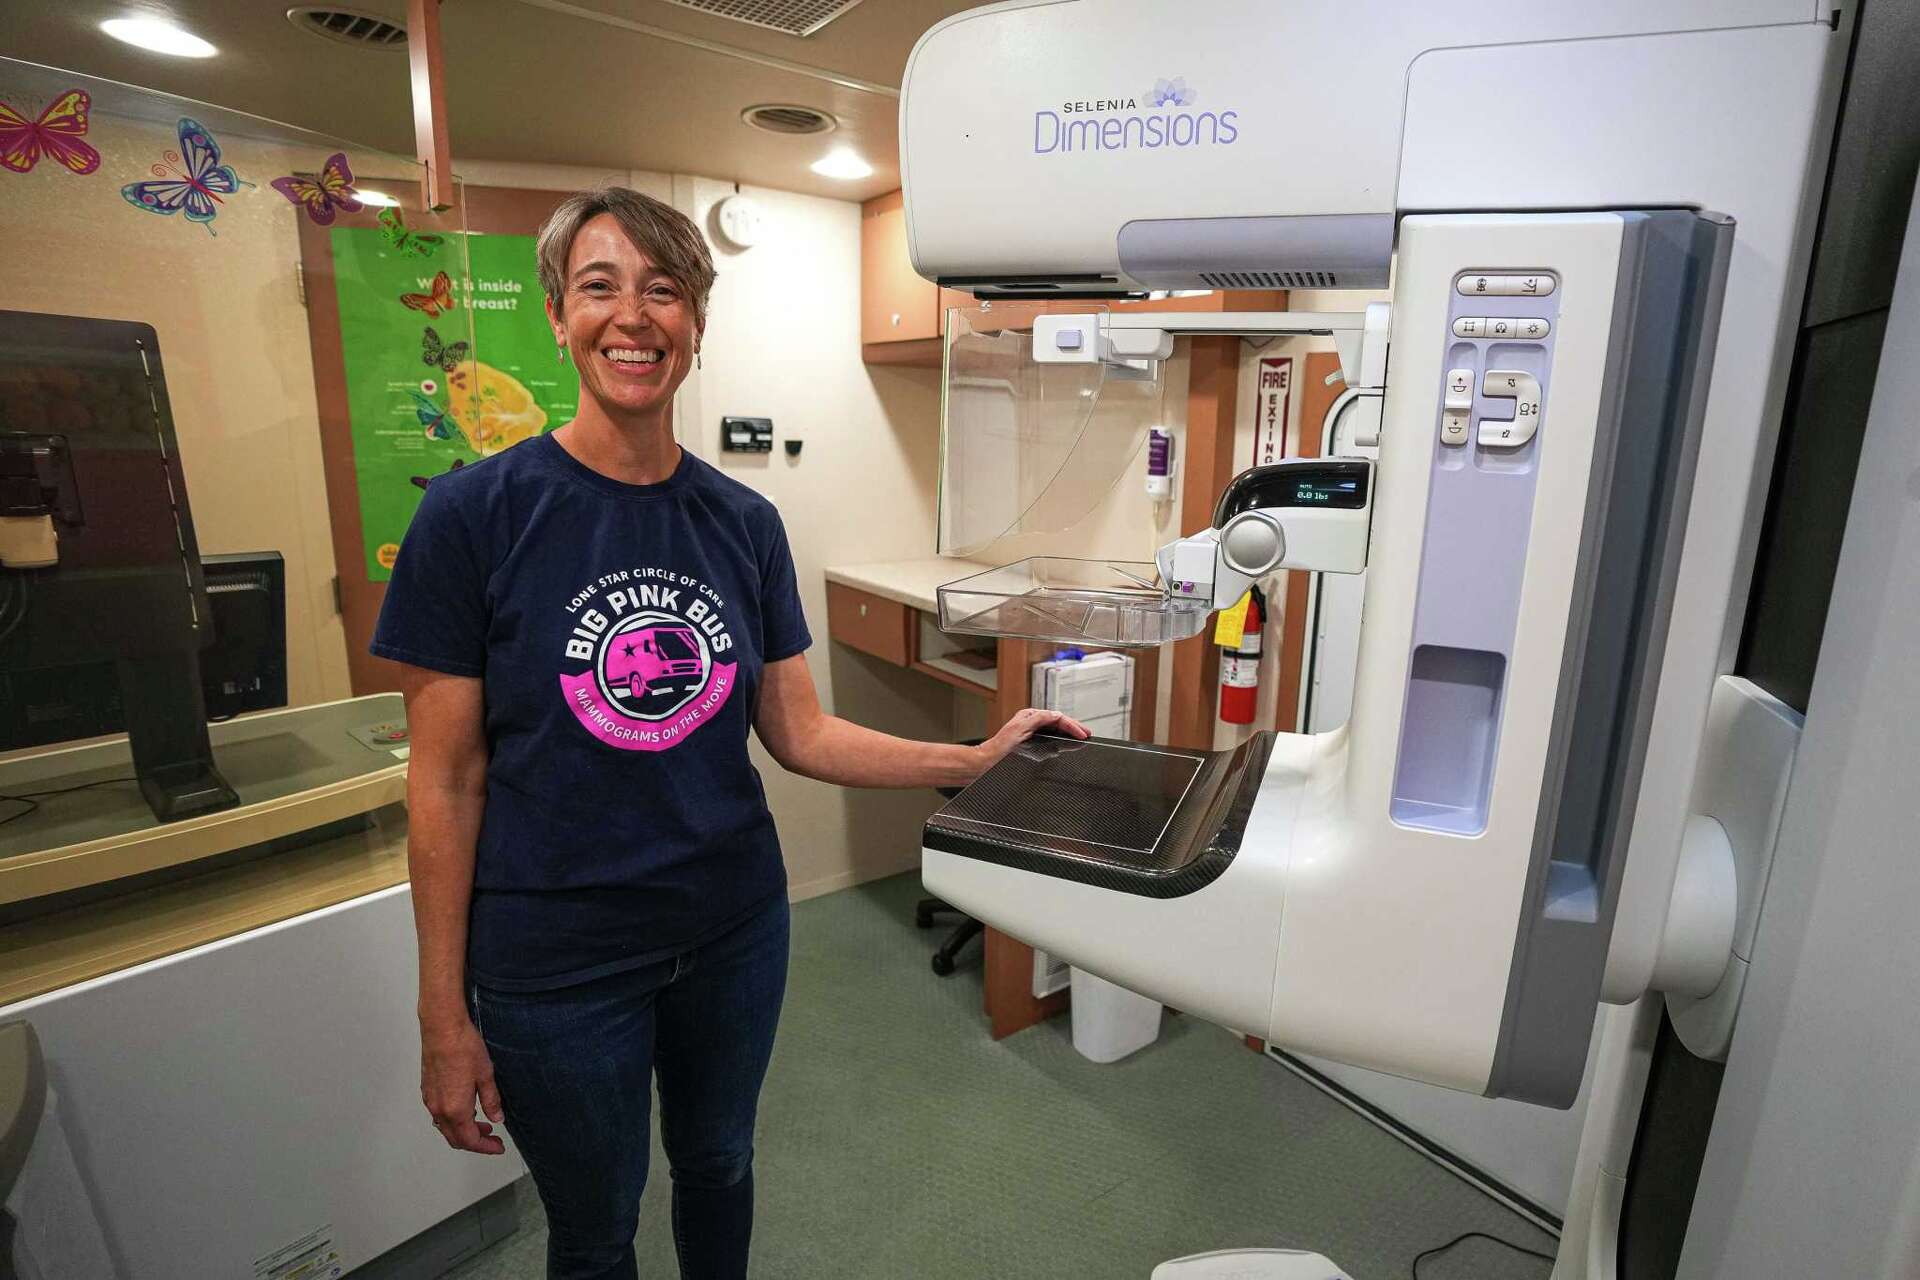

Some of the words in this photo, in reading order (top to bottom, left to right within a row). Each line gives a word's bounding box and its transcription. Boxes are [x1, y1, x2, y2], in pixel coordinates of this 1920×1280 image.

[1063, 98, 1137, 113] SELENIA
[1034, 111, 1239, 154] Dimensions
[416, 278, 459, 291] Wt
[479, 279, 522, 293] inside
[1262, 371, 1288, 389] FIRE
[565, 584, 598, 614] LONE
[598, 571, 630, 588] STAR
[633, 567, 676, 582] CIRCLE
[680, 576, 697, 588] OF
[699, 584, 725, 609] CARE
[565, 608, 609, 661] BIG
[606, 584, 681, 616] PINK
[685, 599, 733, 653] BUS
[574, 687, 660, 743] MAMMOGRAMS
[662, 726, 679, 740] ON
[679, 709, 702, 730] THE
[702, 676, 728, 712] MOVE
